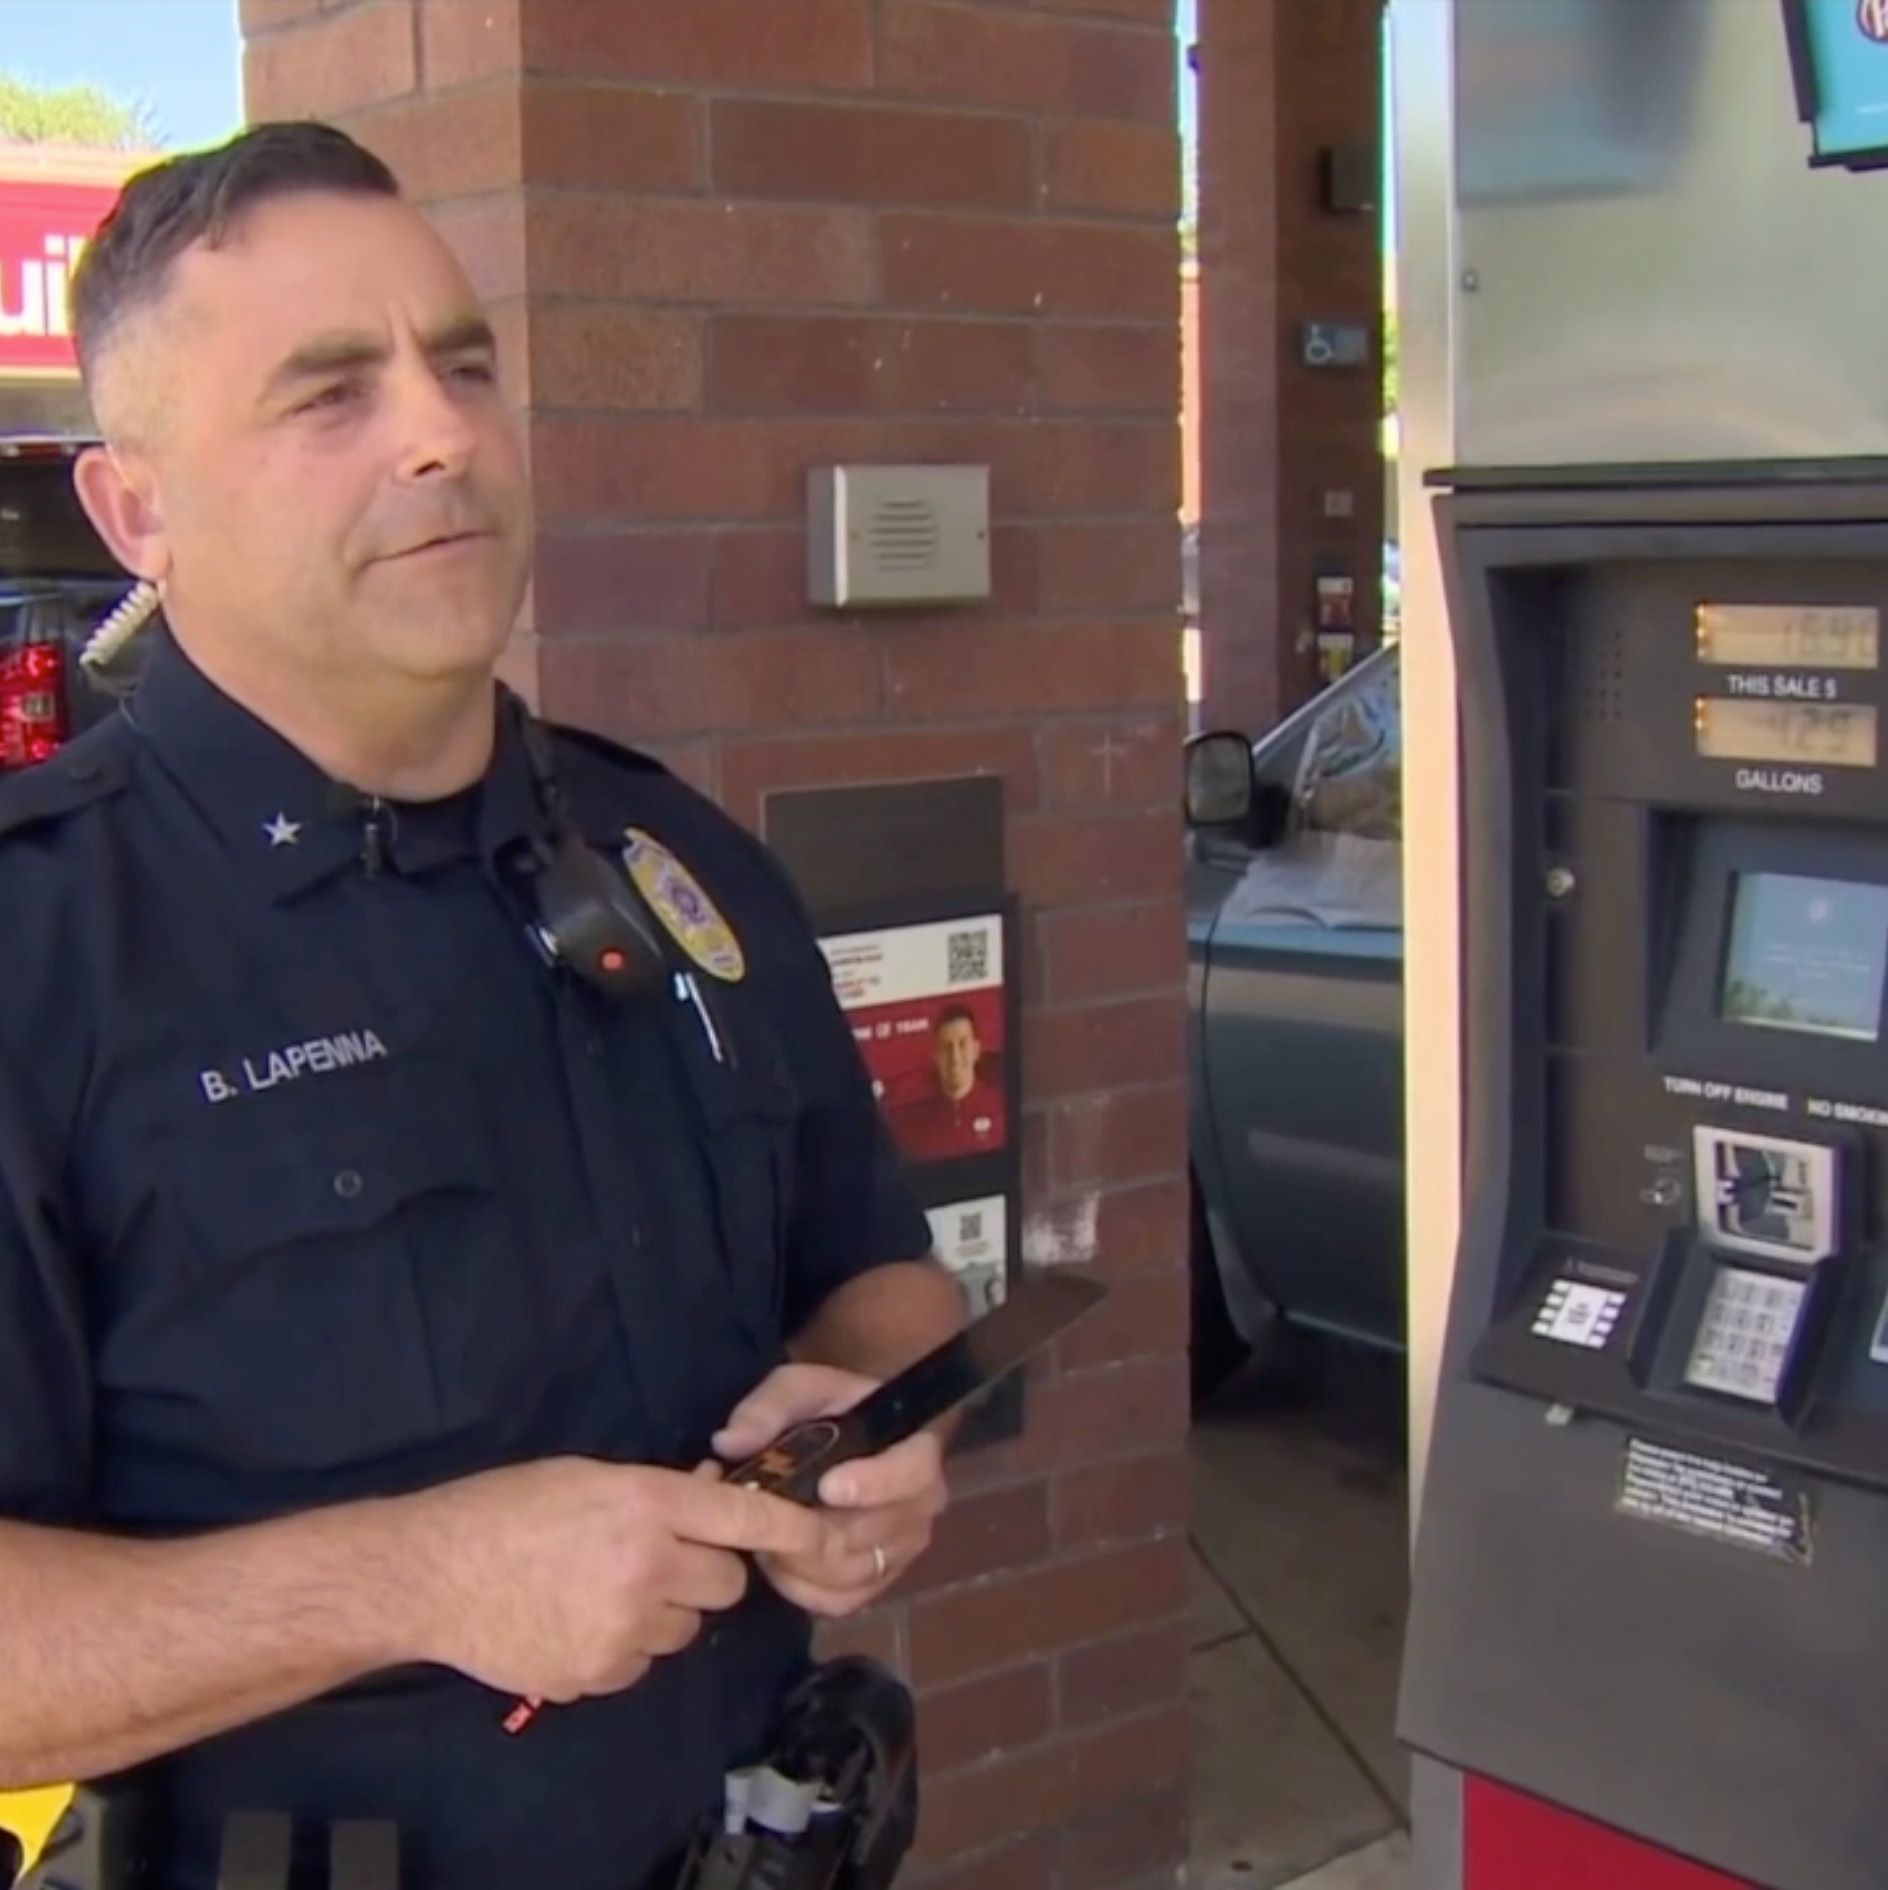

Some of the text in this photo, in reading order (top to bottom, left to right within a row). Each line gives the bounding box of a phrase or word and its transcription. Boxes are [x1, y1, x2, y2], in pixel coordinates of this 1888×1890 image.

[1727, 673, 1770, 695] THIS
[1773, 674, 1820, 697] SALE
[1735, 769, 1823, 794] GALLONS
[201, 1028, 387, 1103] B. LAPENNA
[1663, 1075, 1701, 1096] TURN
[1705, 1081, 1732, 1101] OFF
[1808, 1098, 1831, 1117] NO
